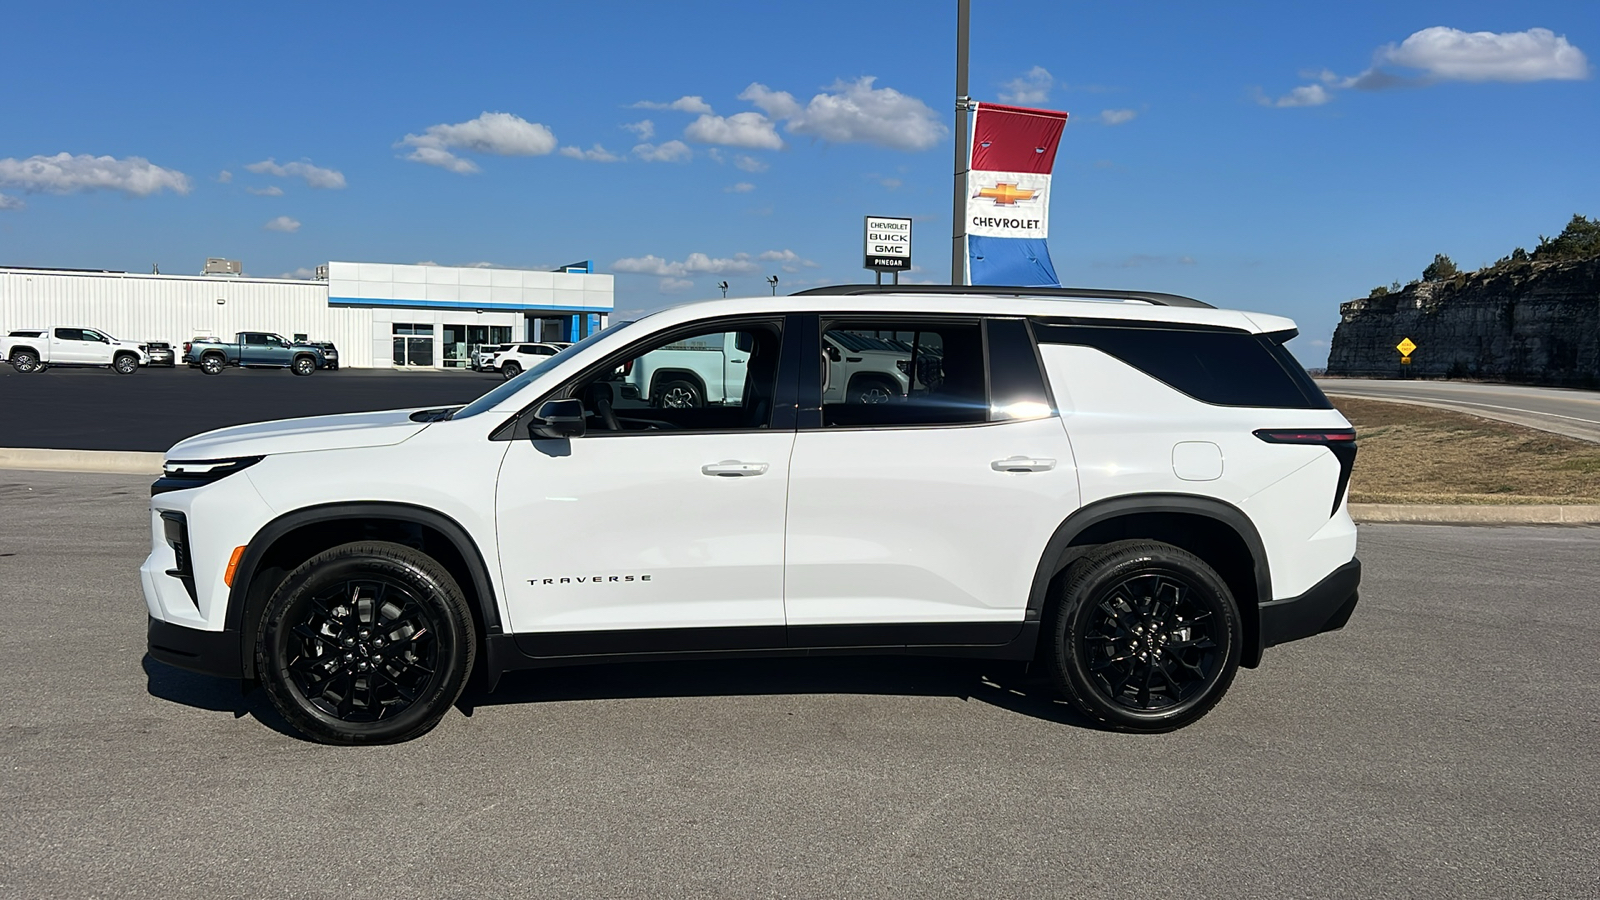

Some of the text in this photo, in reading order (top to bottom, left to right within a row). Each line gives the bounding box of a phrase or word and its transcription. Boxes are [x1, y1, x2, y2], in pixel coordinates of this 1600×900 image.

[870, 222, 908, 230] CHEVROLET
[972, 216, 1040, 229] CHEVROLET
[870, 233, 908, 242] BUICK
[875, 245, 903, 253] GMC
[527, 575, 652, 585] TRAVERSE
